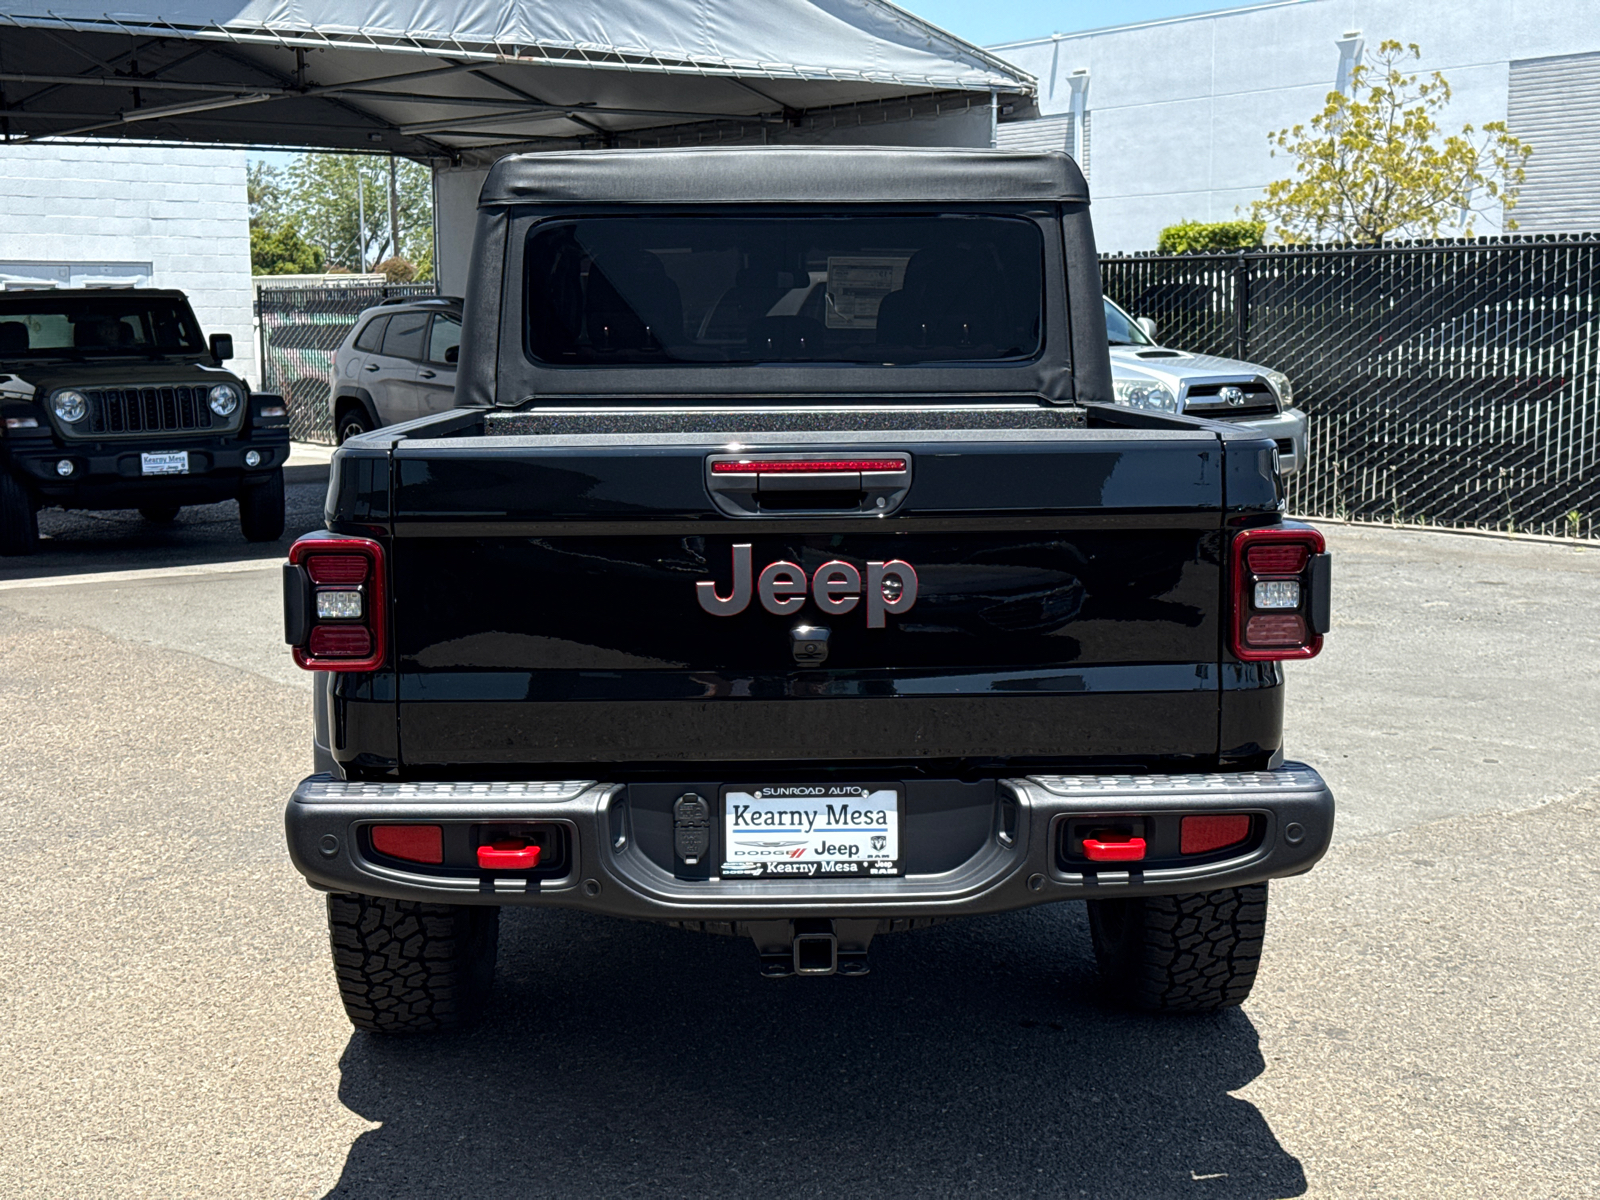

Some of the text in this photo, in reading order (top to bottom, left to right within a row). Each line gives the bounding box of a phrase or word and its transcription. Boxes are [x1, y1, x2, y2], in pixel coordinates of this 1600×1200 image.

[144, 456, 166, 464] Kearny
[696, 543, 918, 629] Jeep
[762, 786, 862, 796] SUNROAD AUTO
[732, 803, 888, 833] Kearny Mesa
[814, 840, 859, 858] Jeep
[766, 861, 858, 875] Kearny Mesa
[874, 860, 893, 868] Jeep
